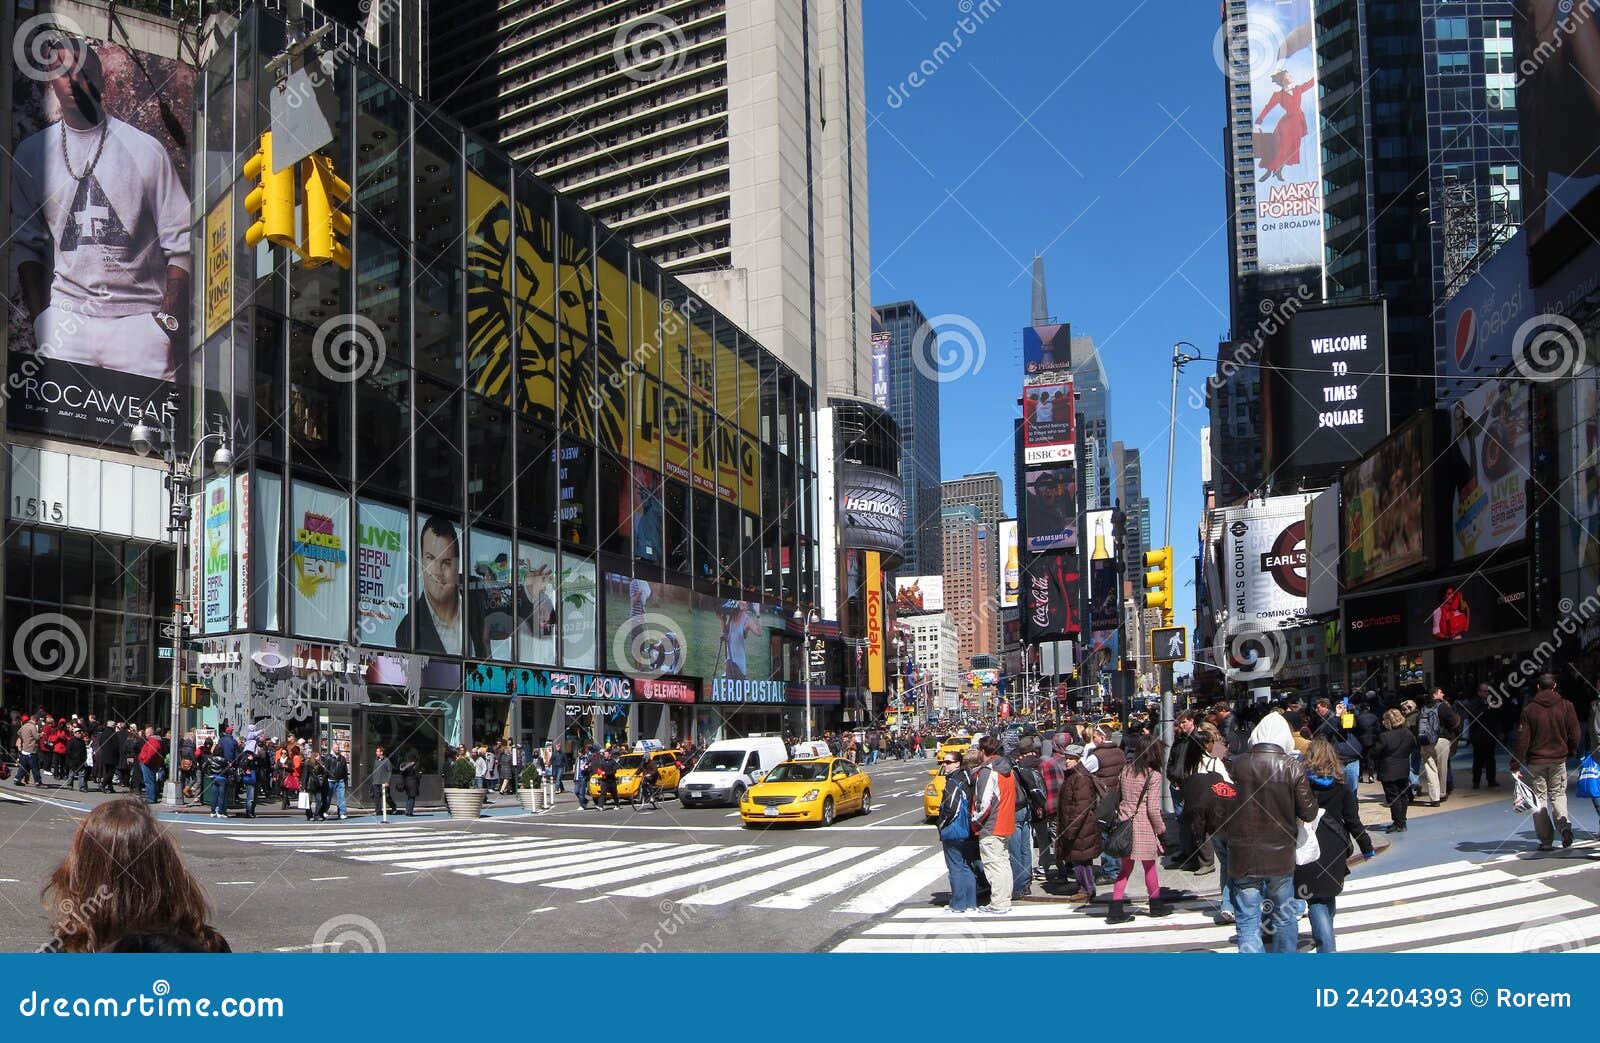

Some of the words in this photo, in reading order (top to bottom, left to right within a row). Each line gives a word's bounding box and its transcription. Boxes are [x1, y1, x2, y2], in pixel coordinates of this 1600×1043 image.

[1270, 181, 1318, 202] MARY
[1259, 198, 1321, 218] POPPIN
[212, 222, 227, 248] THE
[1262, 223, 1276, 231] ON
[1279, 219, 1321, 230] BROADWA
[209, 245, 229, 286] LION
[209, 277, 229, 319] KING
[1481, 283, 1522, 352] pepsi
[1311, 334, 1367, 354] WELCOME
[678, 344, 715, 390] THE
[1038, 361, 1070, 371] Prudential
[1332, 361, 1348, 377] TO
[872, 354, 888, 410] TIME
[1323, 385, 1358, 402] TIMES
[640, 364, 699, 449] LION
[702, 409, 753, 477] KING
[1318, 408, 1364, 428] SQUARE
[1027, 449, 1056, 461] HSBC
[15, 495, 64, 522] 1515
[297, 528, 341, 549] CHOICE
[359, 523, 401, 552] LIVE!
[1036, 534, 1069, 542] SAMSUNG
[207, 552, 229, 575] LIVE!
[359, 547, 391, 567] APRIL
[1235, 539, 1245, 578] COURT
[1265, 554, 1307, 567] EARL'S
[359, 563, 382, 580] 2ND
[207, 575, 224, 590] APRIL
[359, 579, 384, 598] 8PM
[1235, 580, 1246, 621] EARL'S
[1256, 609, 1291, 618] COMING
[1292, 607, 1309, 615] SO
[868, 590, 881, 657] Kodak
[291, 656, 370, 675] OAKLEY
[568, 674, 631, 699] BILLABONG
[654, 683, 688, 698] ELEMENT
